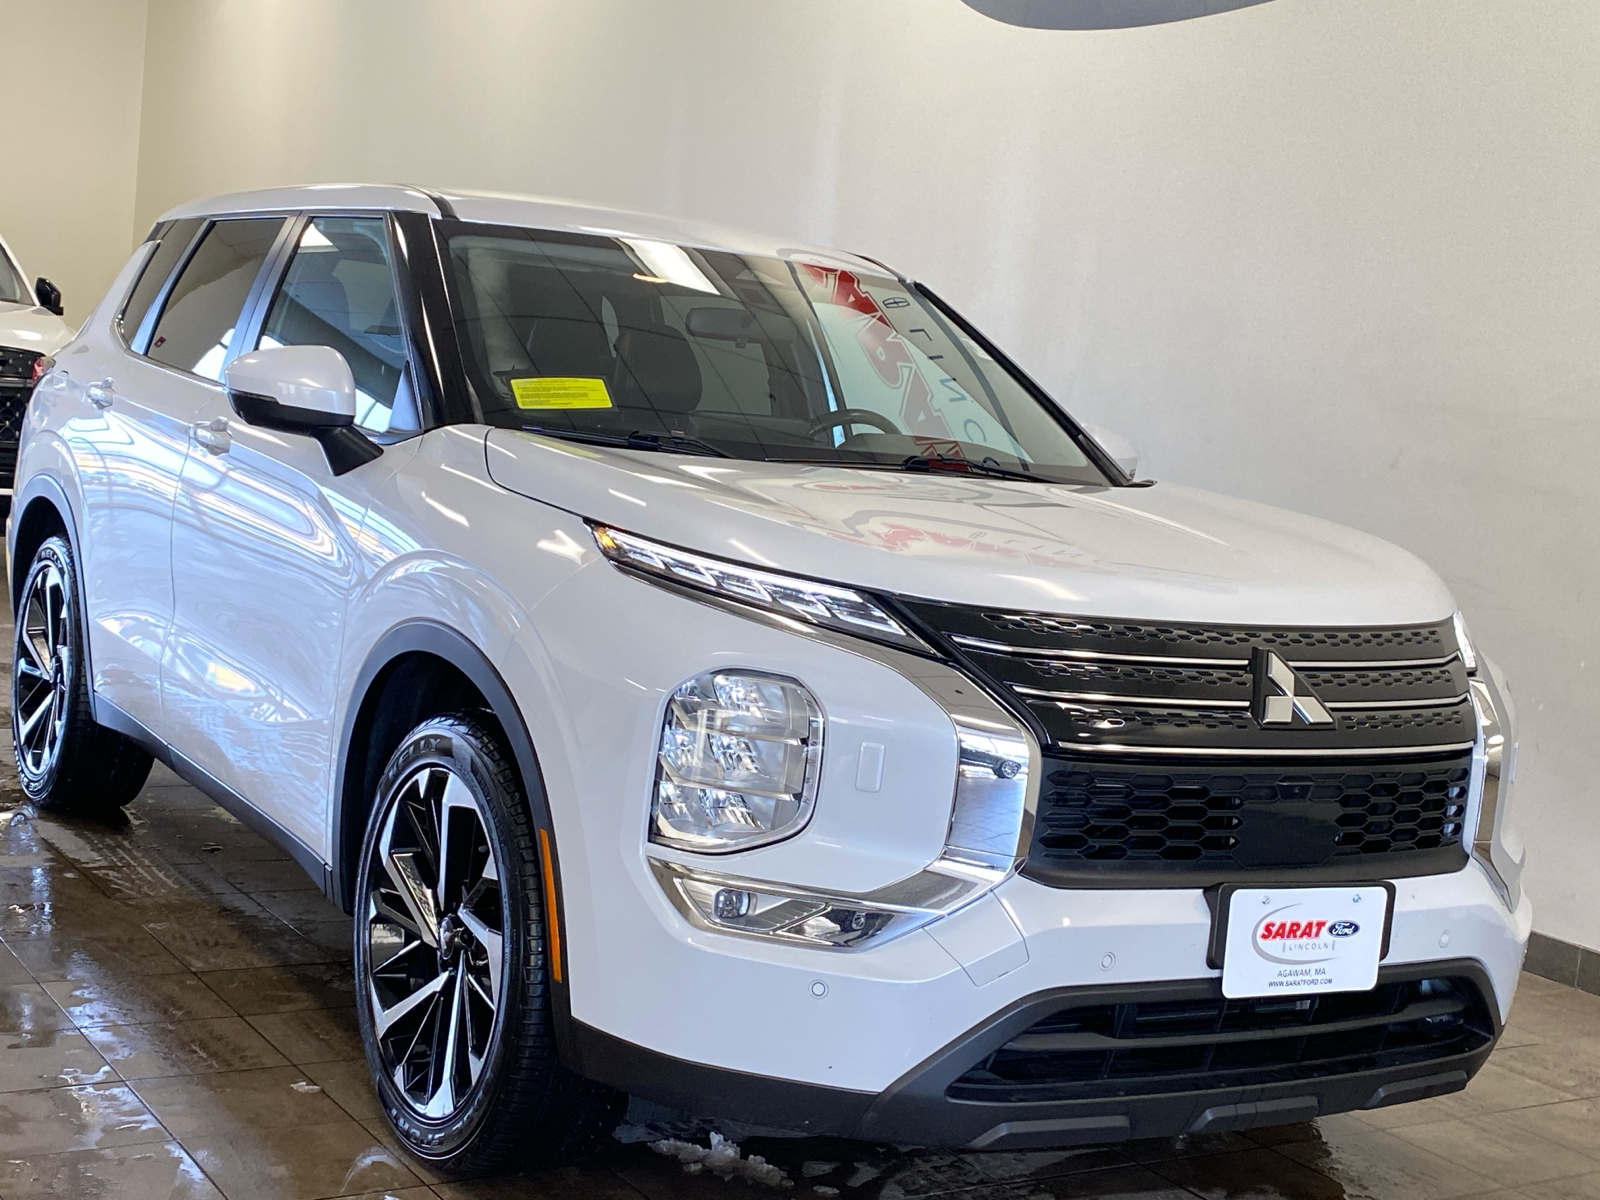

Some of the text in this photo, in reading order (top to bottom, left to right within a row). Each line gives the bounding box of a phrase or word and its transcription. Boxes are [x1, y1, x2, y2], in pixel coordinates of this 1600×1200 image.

[1261, 920, 1354, 940] SARAT Ford
[1288, 942, 1329, 951] LINCOLN
[1277, 968, 1327, 978] AGAWAM, MA
[1268, 978, 1333, 988] WWW.SARATFORD.COM
